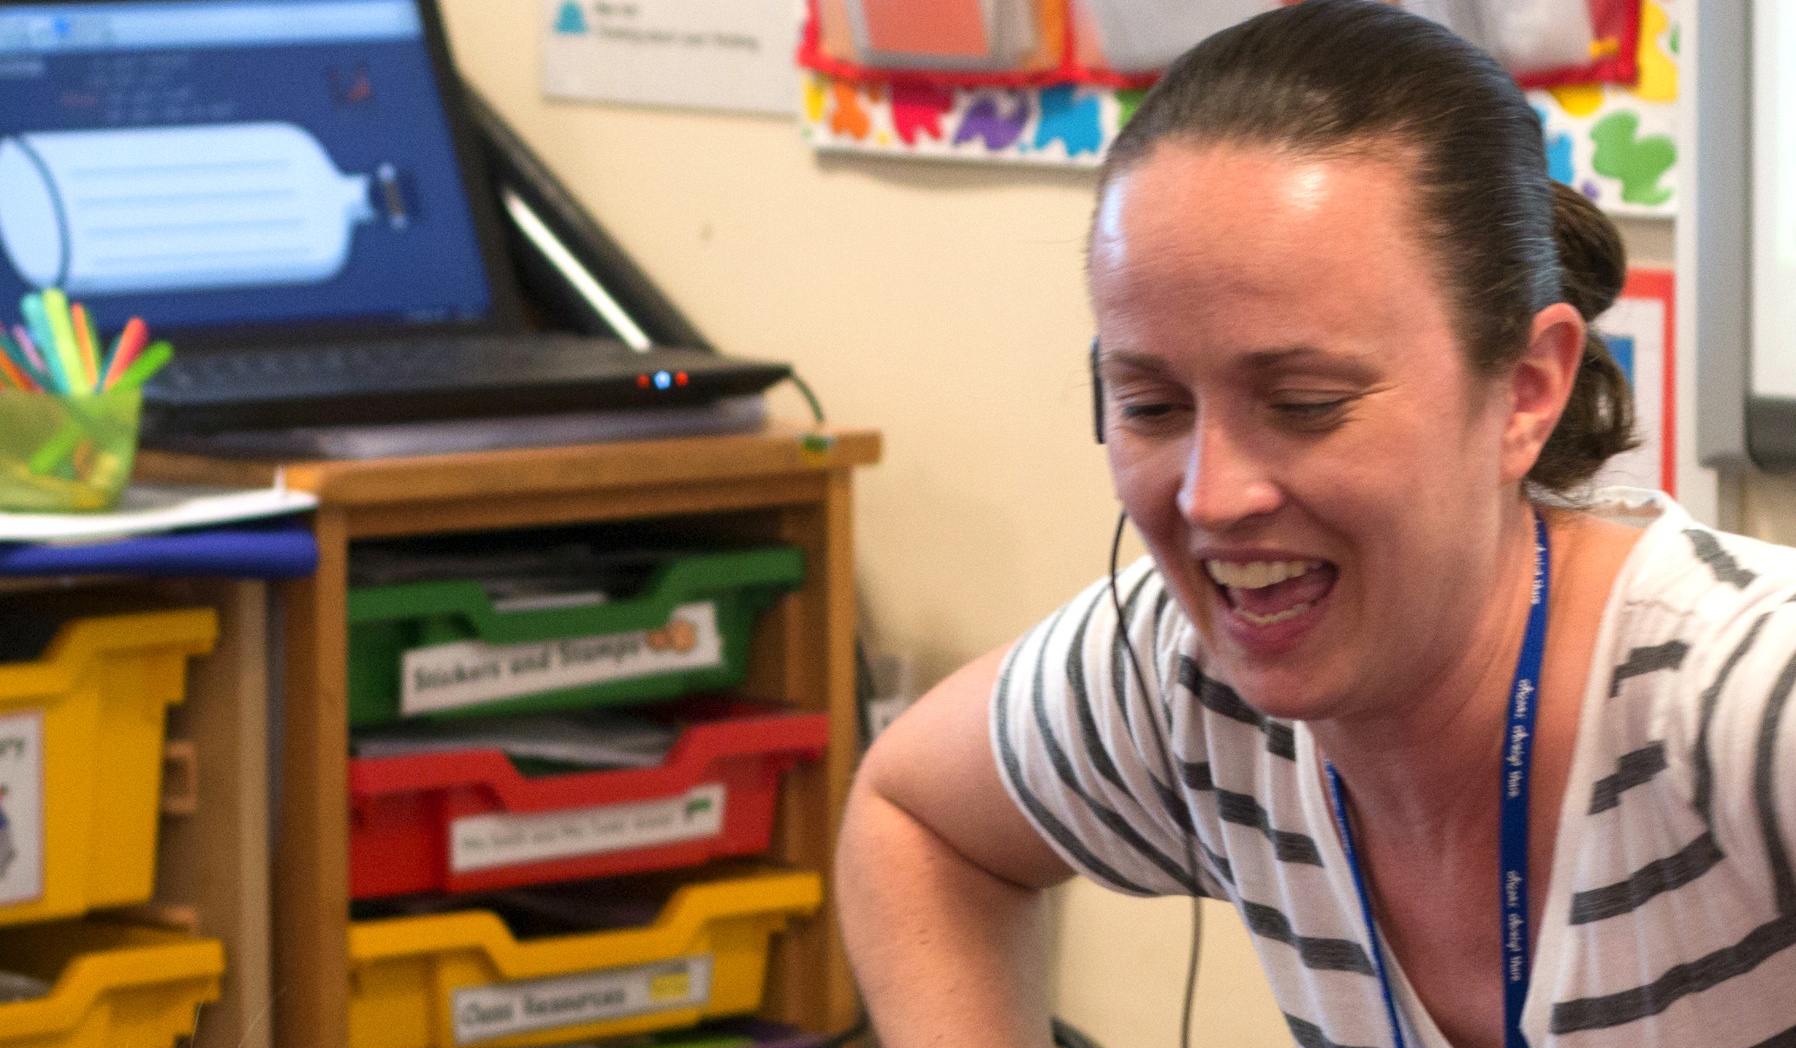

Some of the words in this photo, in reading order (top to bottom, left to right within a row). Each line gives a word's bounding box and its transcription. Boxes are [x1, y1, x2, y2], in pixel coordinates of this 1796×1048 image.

[414, 661, 500, 692] Stickers
[510, 649, 549, 677] and
[461, 1001, 514, 1026] Class
[523, 987, 626, 1016] Resources
